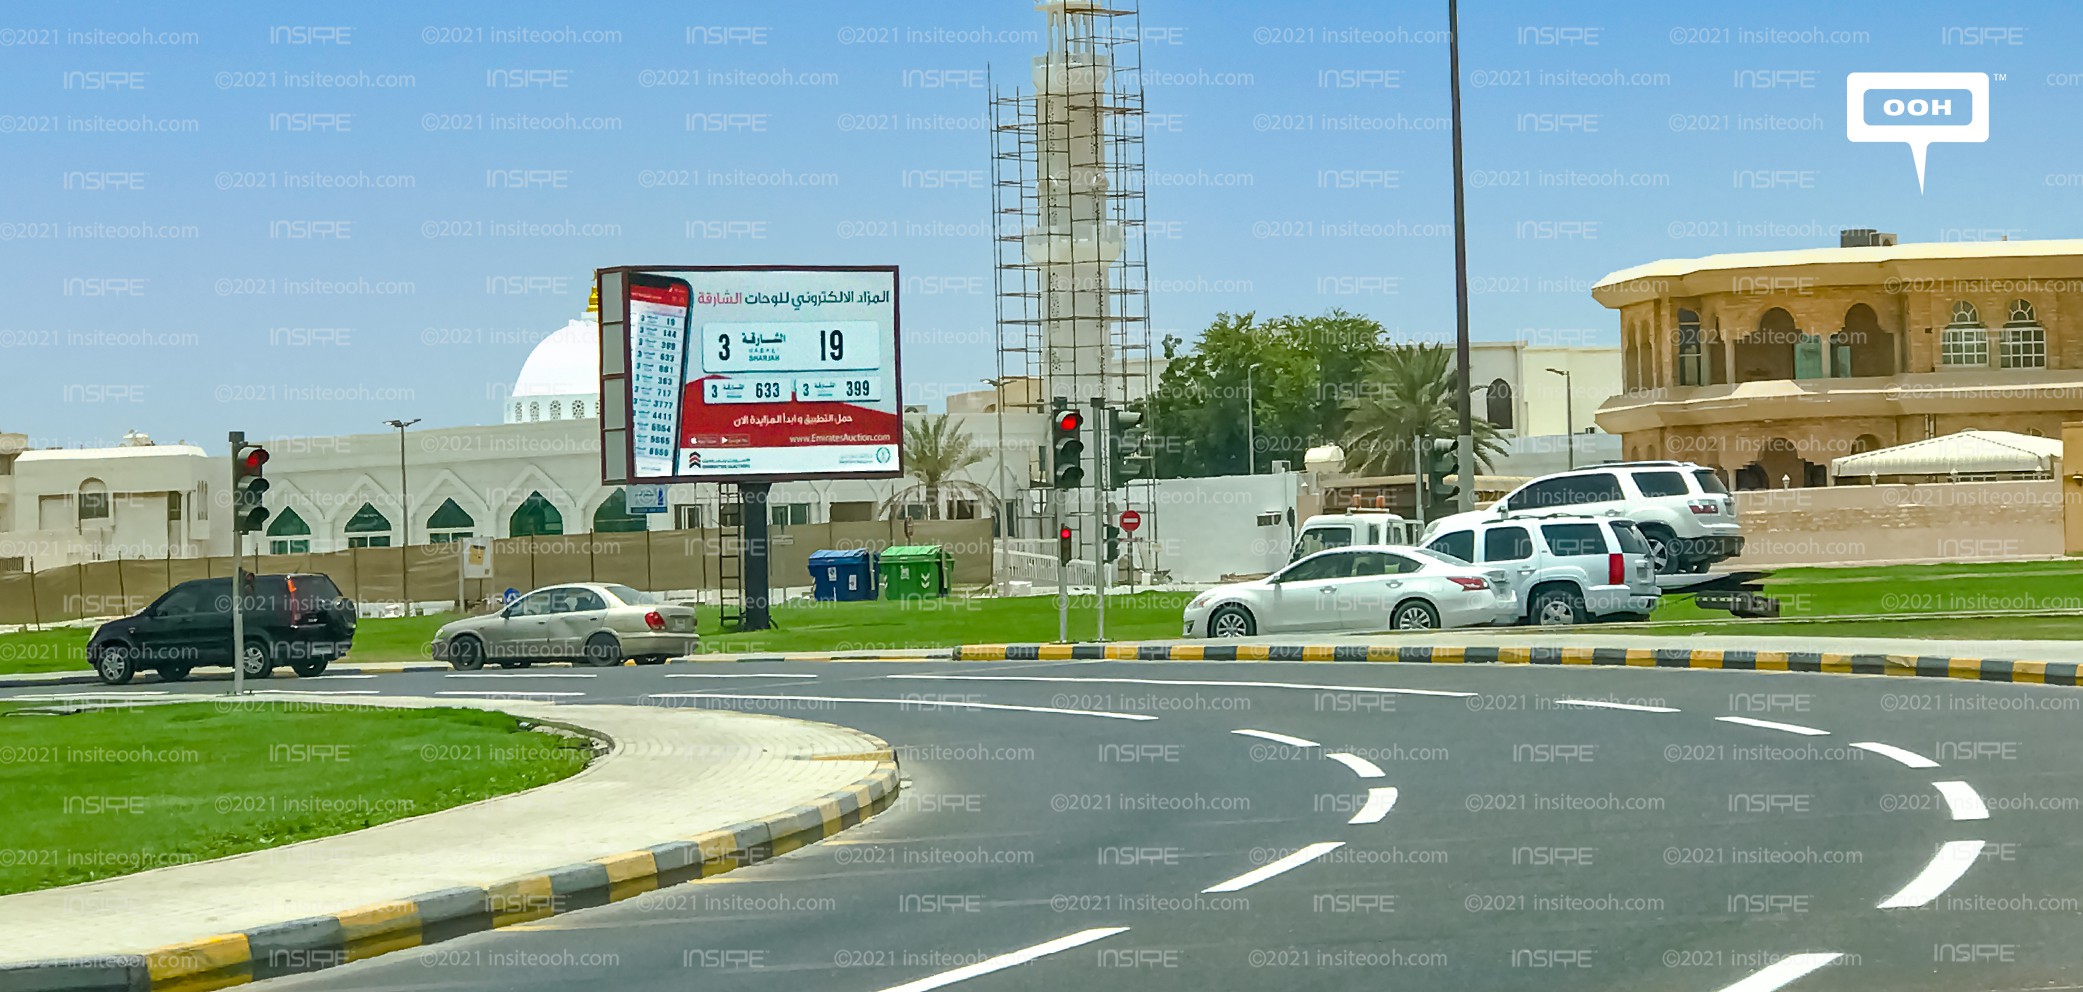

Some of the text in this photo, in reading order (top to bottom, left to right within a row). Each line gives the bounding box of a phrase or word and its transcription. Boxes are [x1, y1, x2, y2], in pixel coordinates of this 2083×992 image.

[698, 289, 742, 307] الشارقة
[744, 291, 790, 307] للوحات
[857, 290, 890, 306] المزاد
[718, 333, 731, 361] 3
[741, 331, 786, 347] الشارقة
[819, 329, 844, 362] 19
[748, 354, 780, 362] SHARJAH
[657, 388, 671, 397] 717
[711, 384, 718, 399] 3
[755, 382, 780, 399] 633
[802, 383, 810, 397] 3
[846, 380, 870, 397] 399
[652, 412, 672, 421] 4411
[835, 414, 853, 425] حمل
[789, 432, 891, 444] www.EmiratesAuction.com
